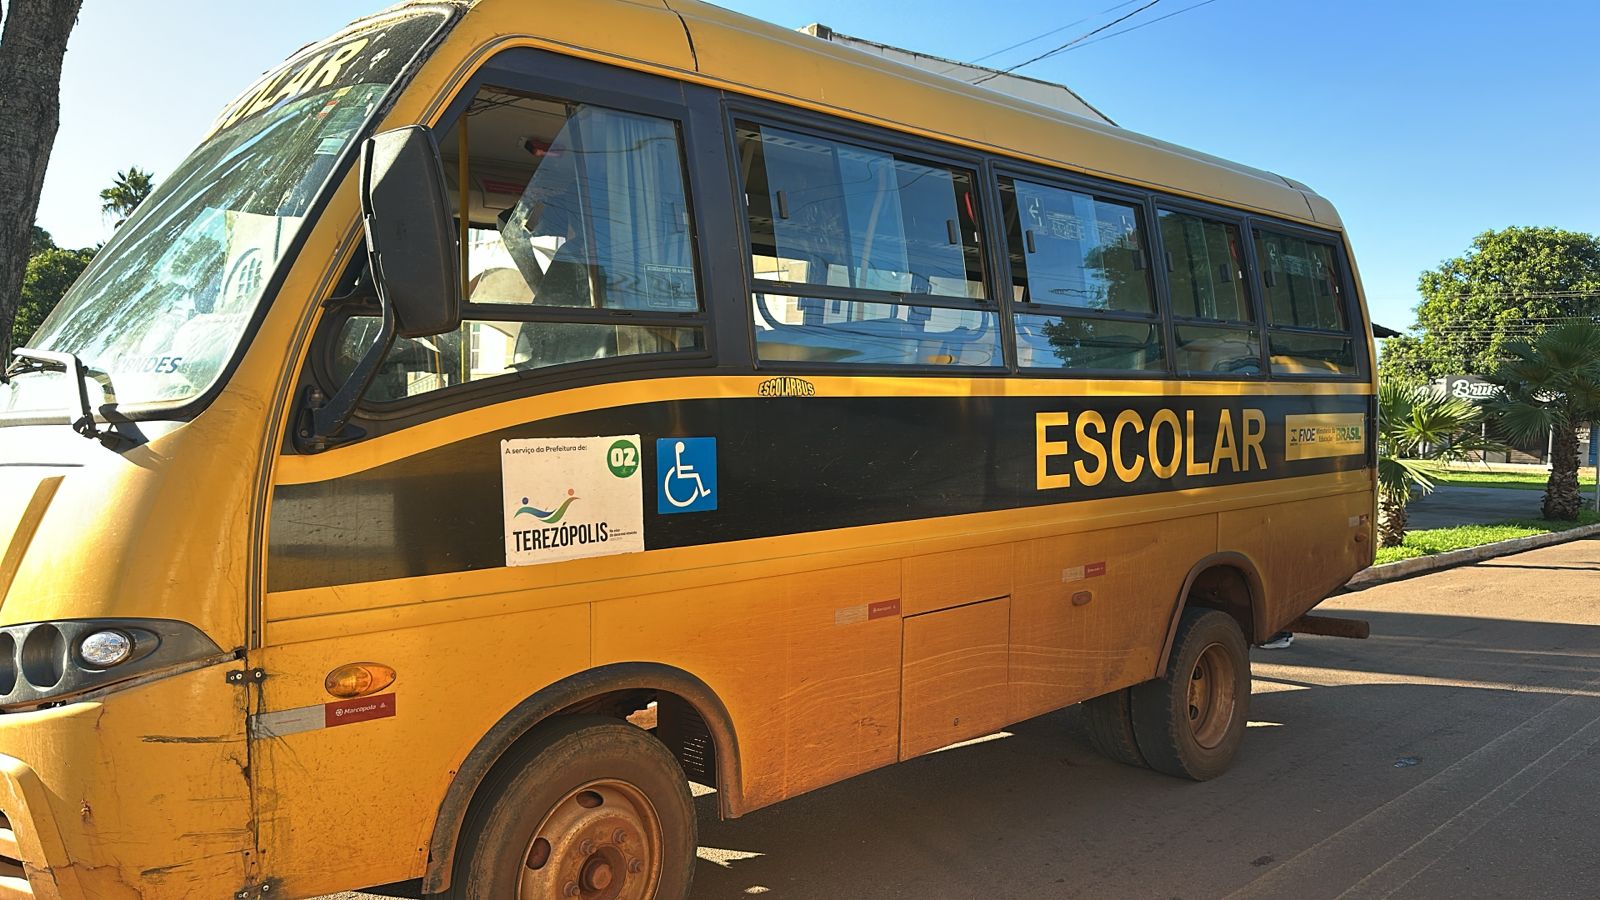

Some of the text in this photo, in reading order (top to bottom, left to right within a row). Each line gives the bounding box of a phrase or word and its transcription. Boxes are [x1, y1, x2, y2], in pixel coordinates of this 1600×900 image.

[758, 377, 815, 396] ESCOLARBUS
[1298, 427, 1316, 442] FNDE
[1335, 426, 1362, 441] BRASIL
[505, 447, 511, 455] A
[512, 446, 535, 455] serviço
[545, 445, 577, 453] Prefeitura
[610, 447, 637, 467] 02
[1035, 408, 1267, 490] ESCOLAR
[512, 521, 609, 552] TEREZÓPOLIS
[344, 704, 377, 715] Marcopolo
